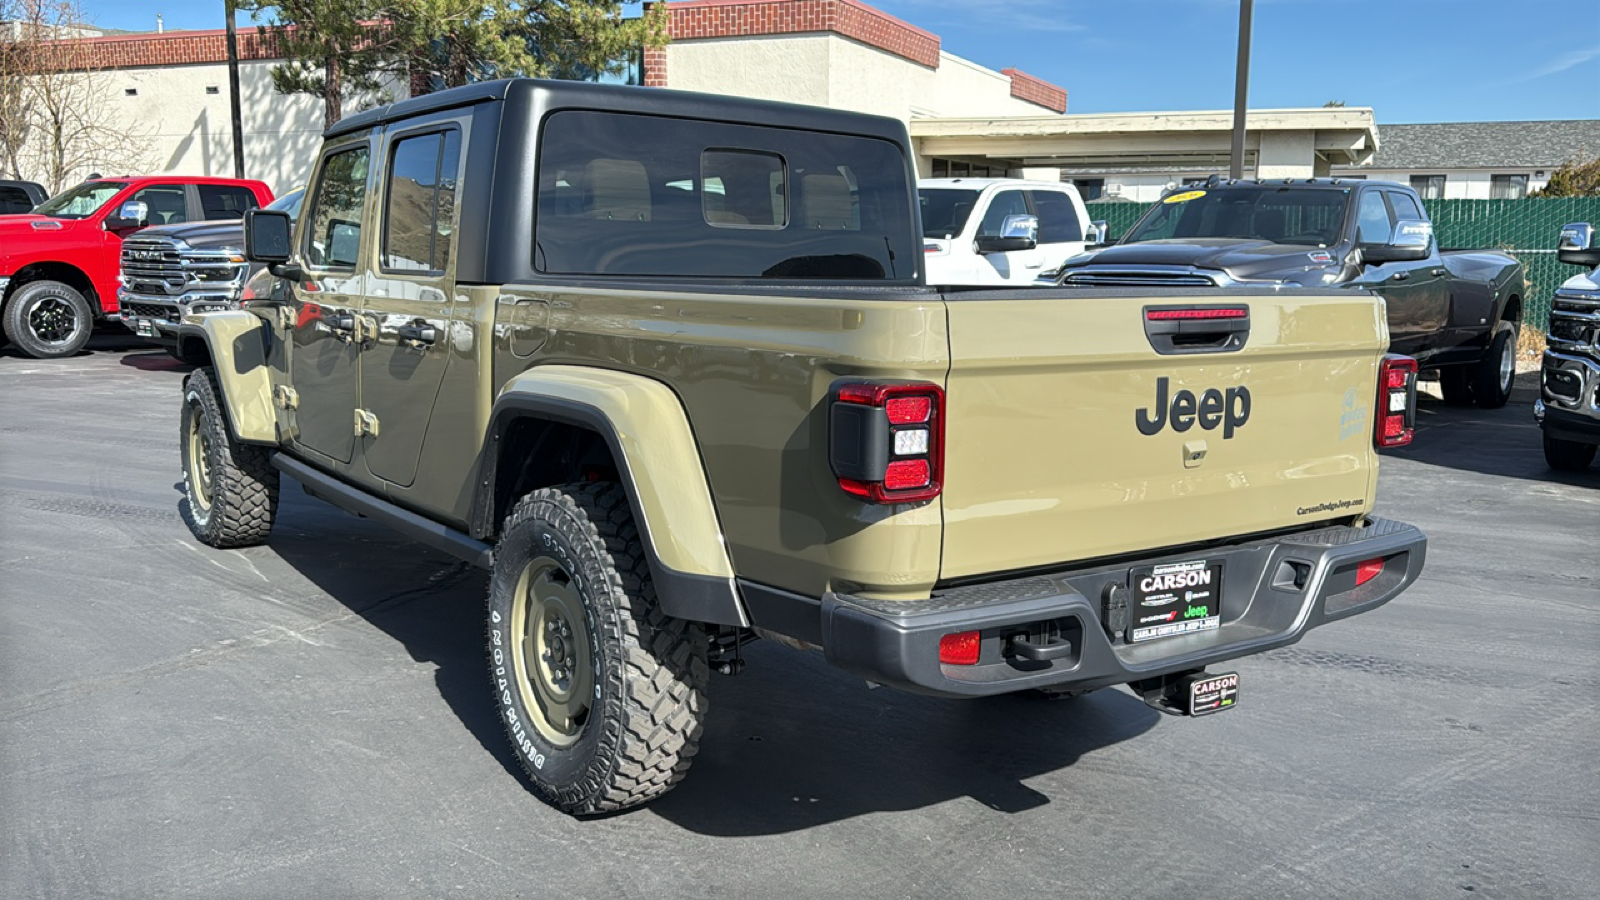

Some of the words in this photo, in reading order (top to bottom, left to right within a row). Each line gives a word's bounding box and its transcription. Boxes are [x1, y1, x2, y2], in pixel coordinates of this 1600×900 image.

[1135, 376, 1252, 440] Jeep
[1296, 499, 1364, 516] CarsonDodgeJeep.com
[1140, 570, 1212, 592] CARSON
[1184, 605, 1208, 618] Jeep
[1194, 676, 1237, 695] CARSON
[491, 630, 546, 771] DESTINATION
